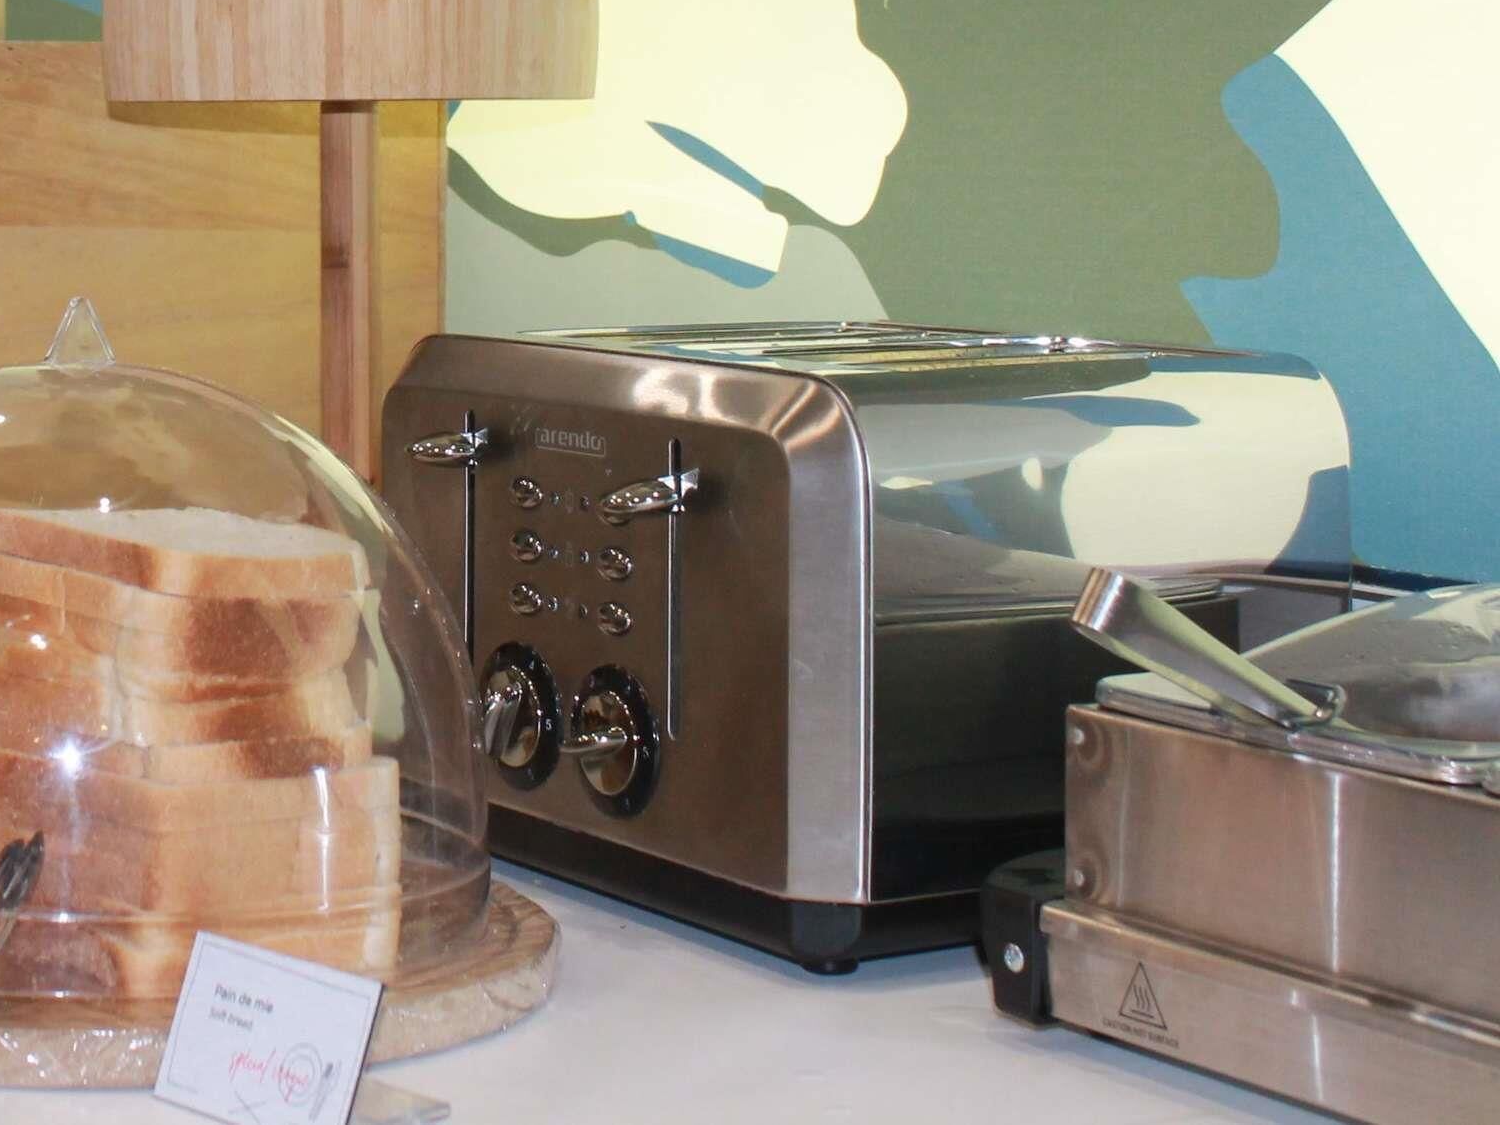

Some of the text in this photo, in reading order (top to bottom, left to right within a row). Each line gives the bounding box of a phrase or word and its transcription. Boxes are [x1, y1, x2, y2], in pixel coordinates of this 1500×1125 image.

[538, 427, 602, 452] arendo
[214, 983, 274, 1014] Pain de mie
